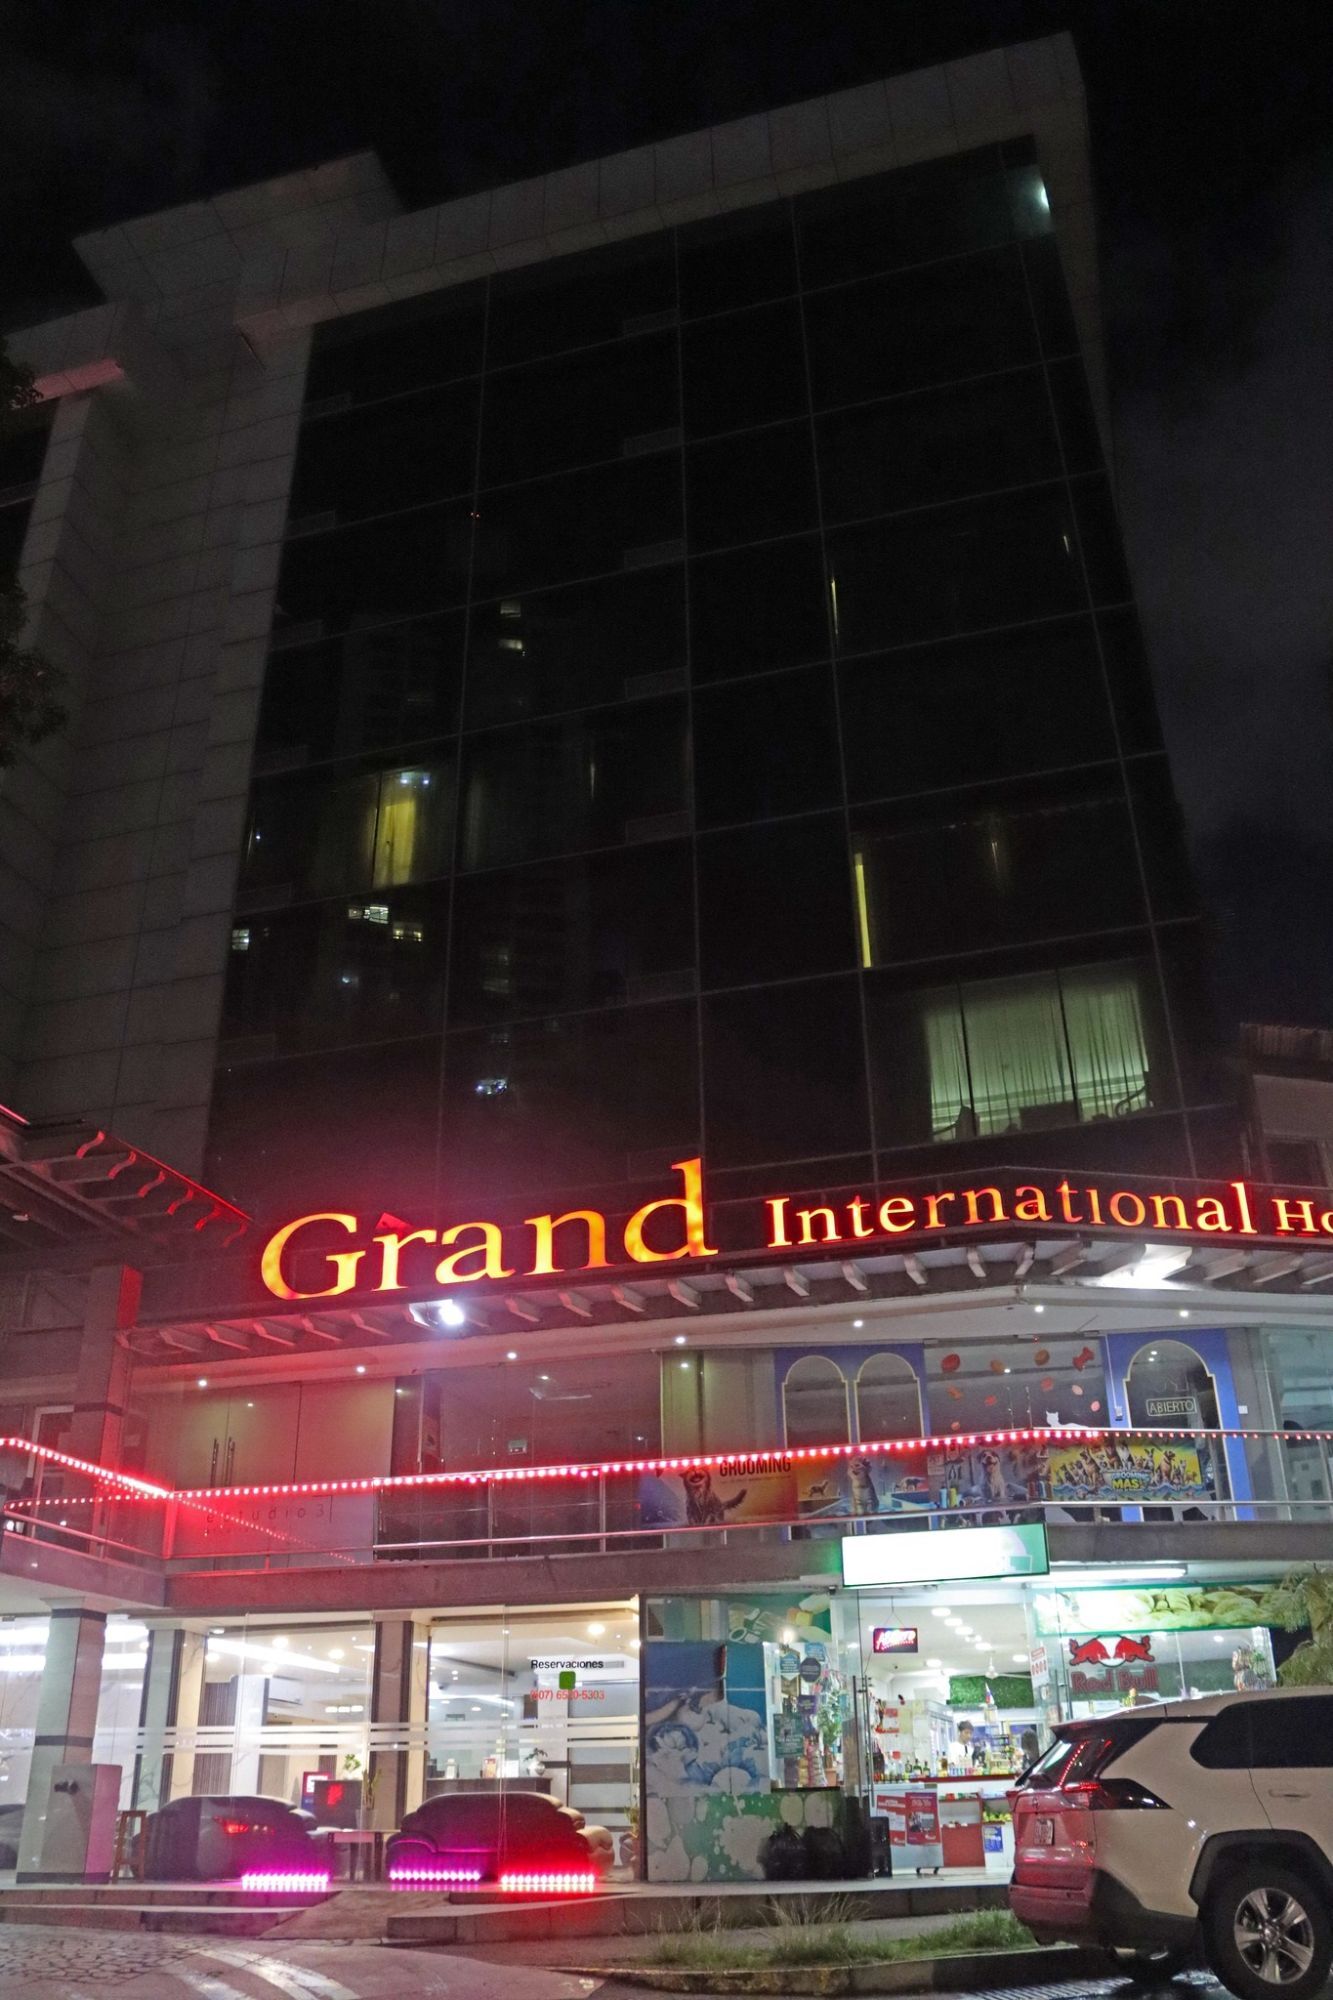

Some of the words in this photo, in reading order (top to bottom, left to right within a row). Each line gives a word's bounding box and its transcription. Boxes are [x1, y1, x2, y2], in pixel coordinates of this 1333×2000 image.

[260, 1157, 718, 1300] Grand
[765, 1179, 1259, 1248] International
[1149, 1400, 1195, 1415] ABIERTO
[718, 1456, 792, 1477] GROOMING
[530, 1659, 605, 1669] Reservaciones
[1070, 1669, 1115, 1694] Red
[1117, 1665, 1160, 1692] Bull
